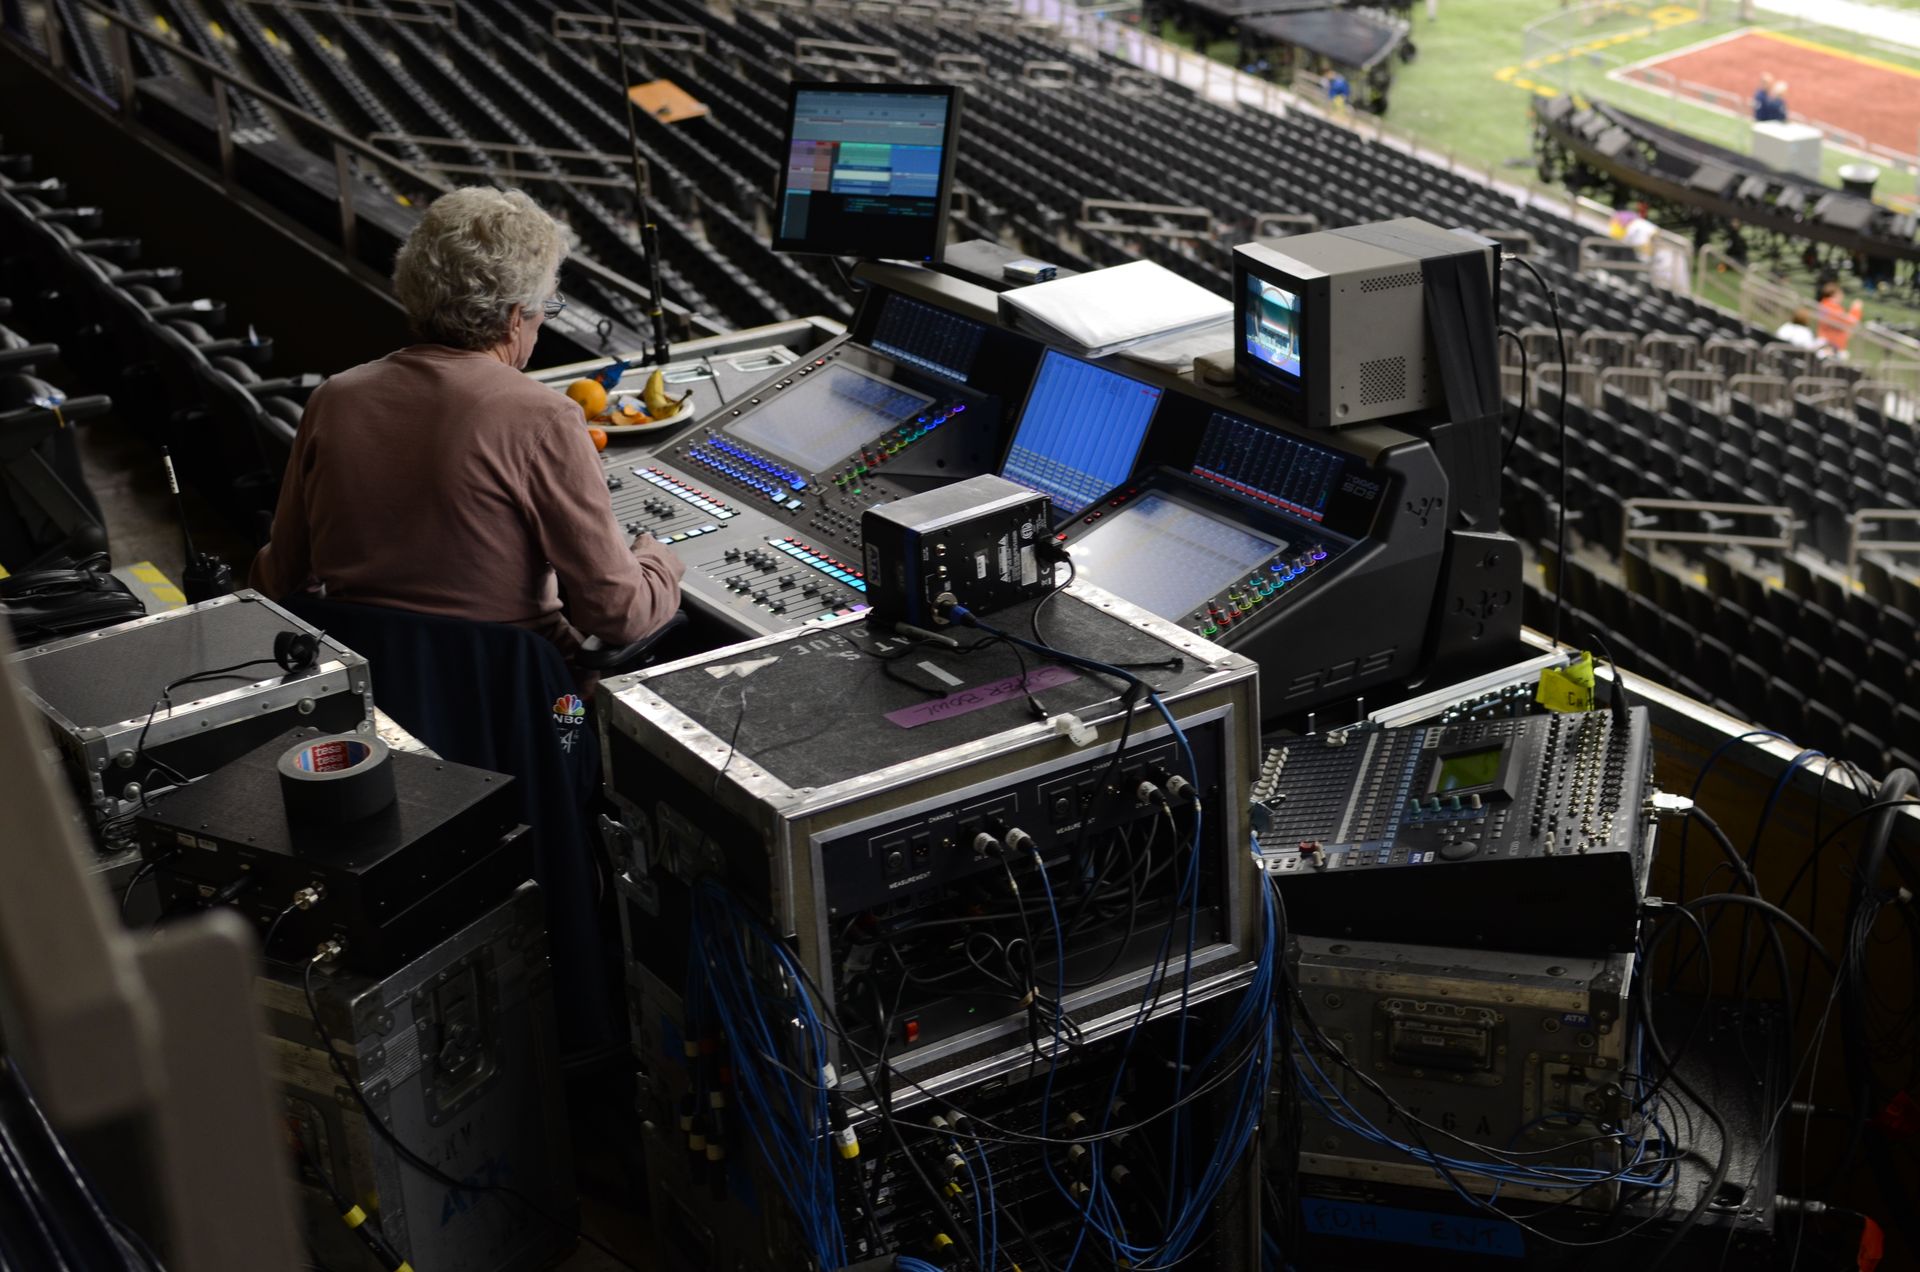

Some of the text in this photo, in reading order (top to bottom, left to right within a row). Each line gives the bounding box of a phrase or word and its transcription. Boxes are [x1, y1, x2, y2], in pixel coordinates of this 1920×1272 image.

[914, 692, 983, 716] BOWL
[553, 713, 584, 725] NBC
[888, 871, 932, 889] MEASUREMENT
[1564, 1014, 1588, 1024] ATK
[1442, 1112, 1457, 1131] 6
[1475, 1115, 1491, 1136] A
